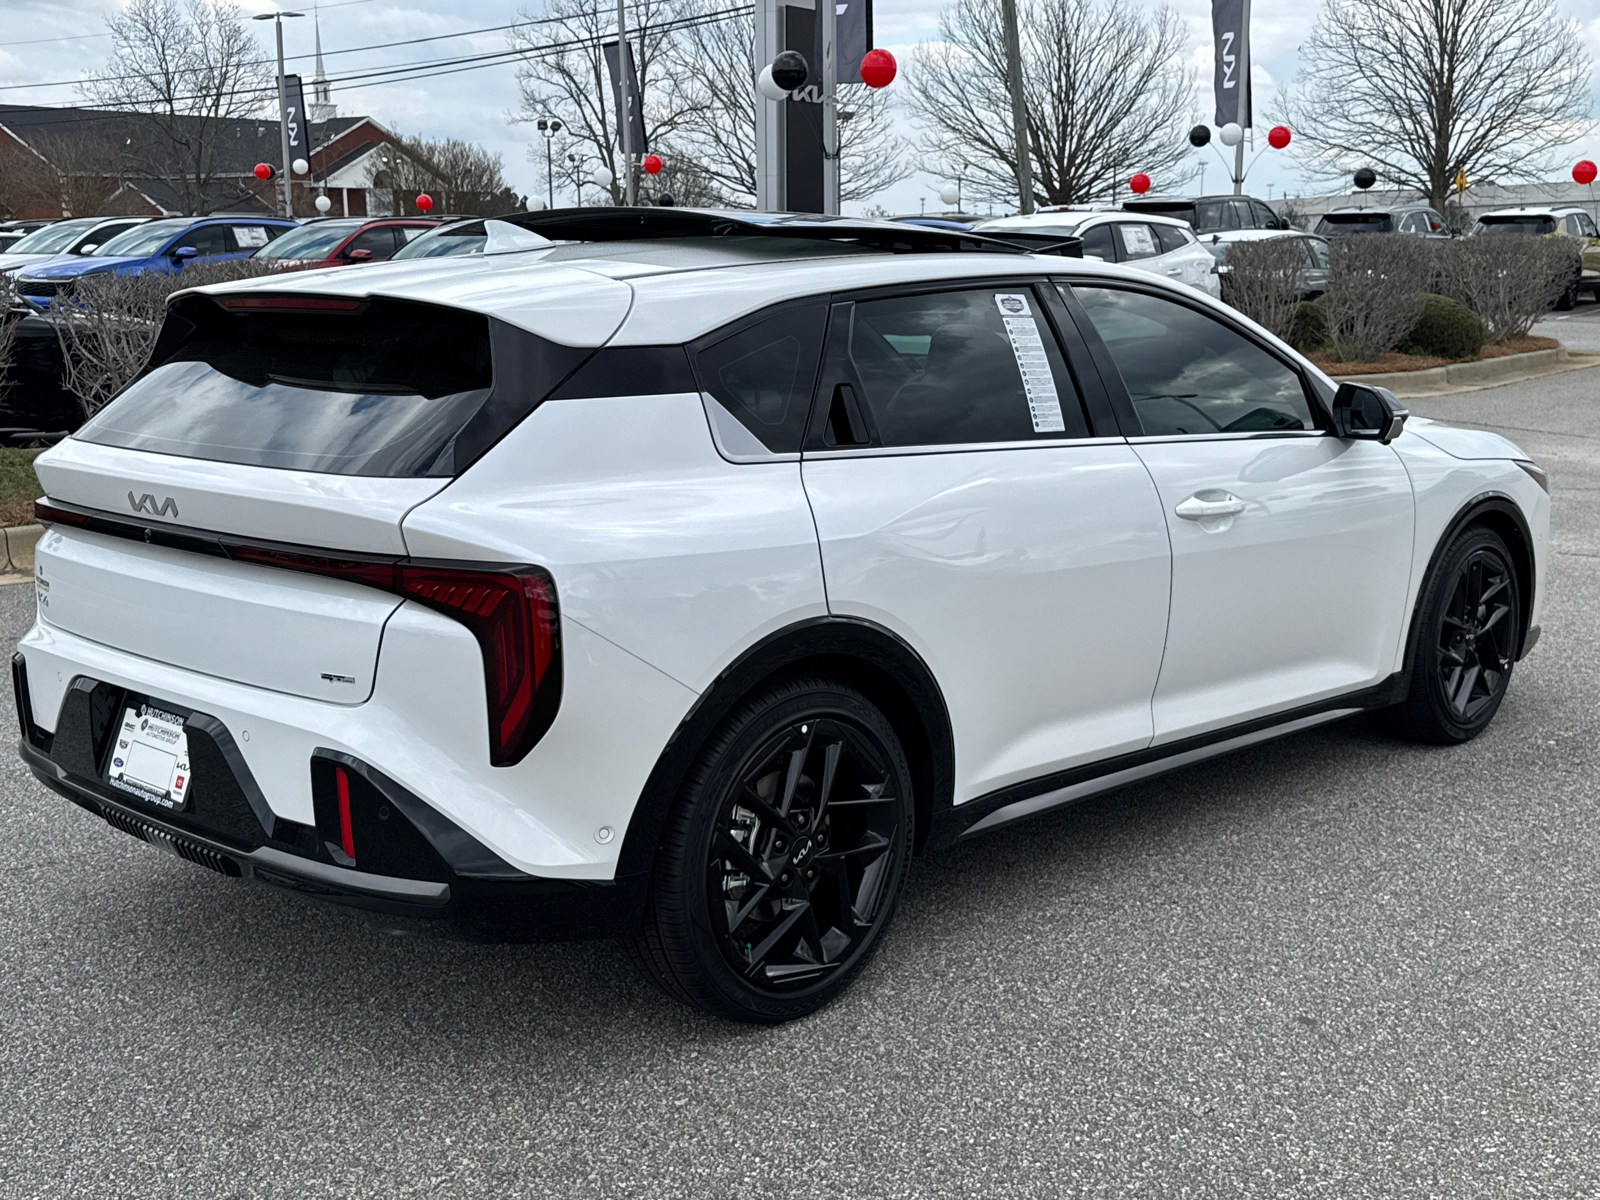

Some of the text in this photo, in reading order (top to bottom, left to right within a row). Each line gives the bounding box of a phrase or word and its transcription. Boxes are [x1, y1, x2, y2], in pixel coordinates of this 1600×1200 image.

[127, 490, 178, 518] KIA
[147, 707, 184, 726] HUTCHINSON
[792, 839, 812, 864] KIA
[897, 814, 913, 894] KUMHO
